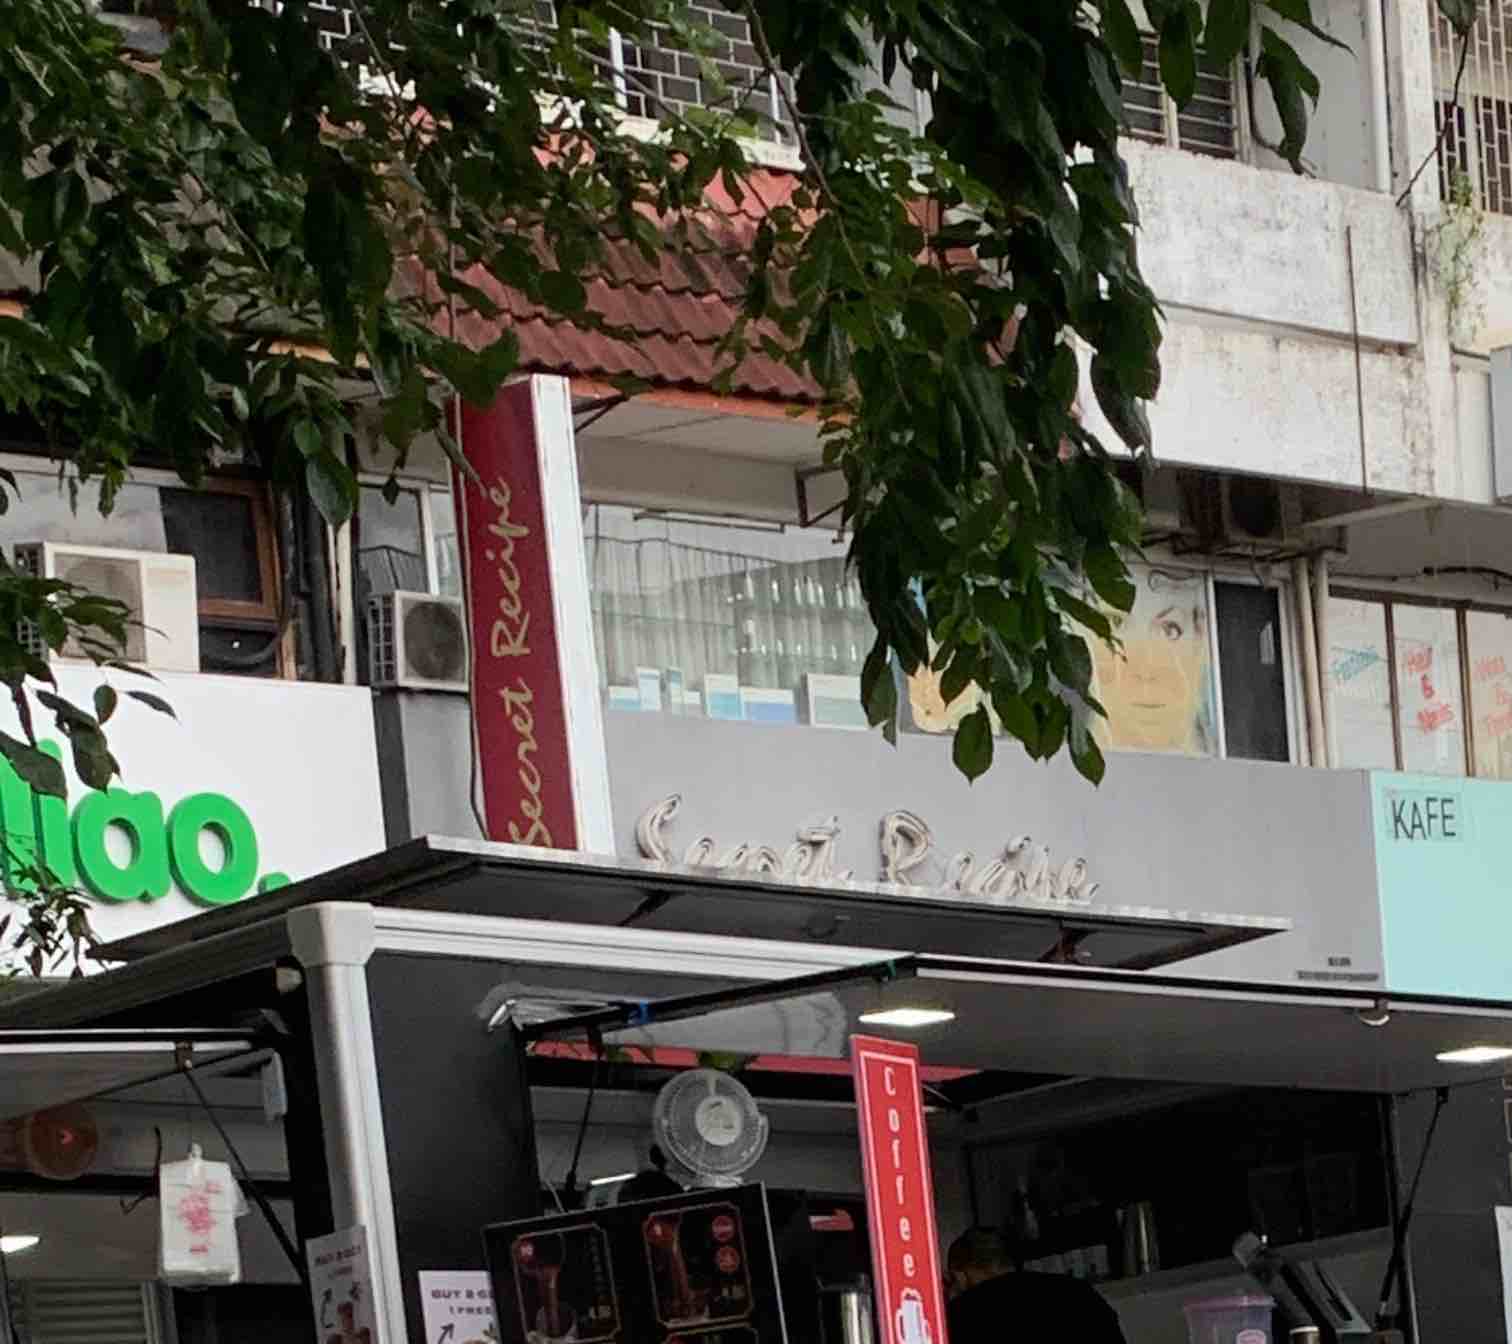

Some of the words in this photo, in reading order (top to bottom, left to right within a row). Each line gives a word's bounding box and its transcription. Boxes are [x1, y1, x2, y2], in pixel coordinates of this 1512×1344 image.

[484, 476, 532, 658] Recipe
[508, 676, 554, 848] Secret
[1391, 796, 1457, 841] KAFE
